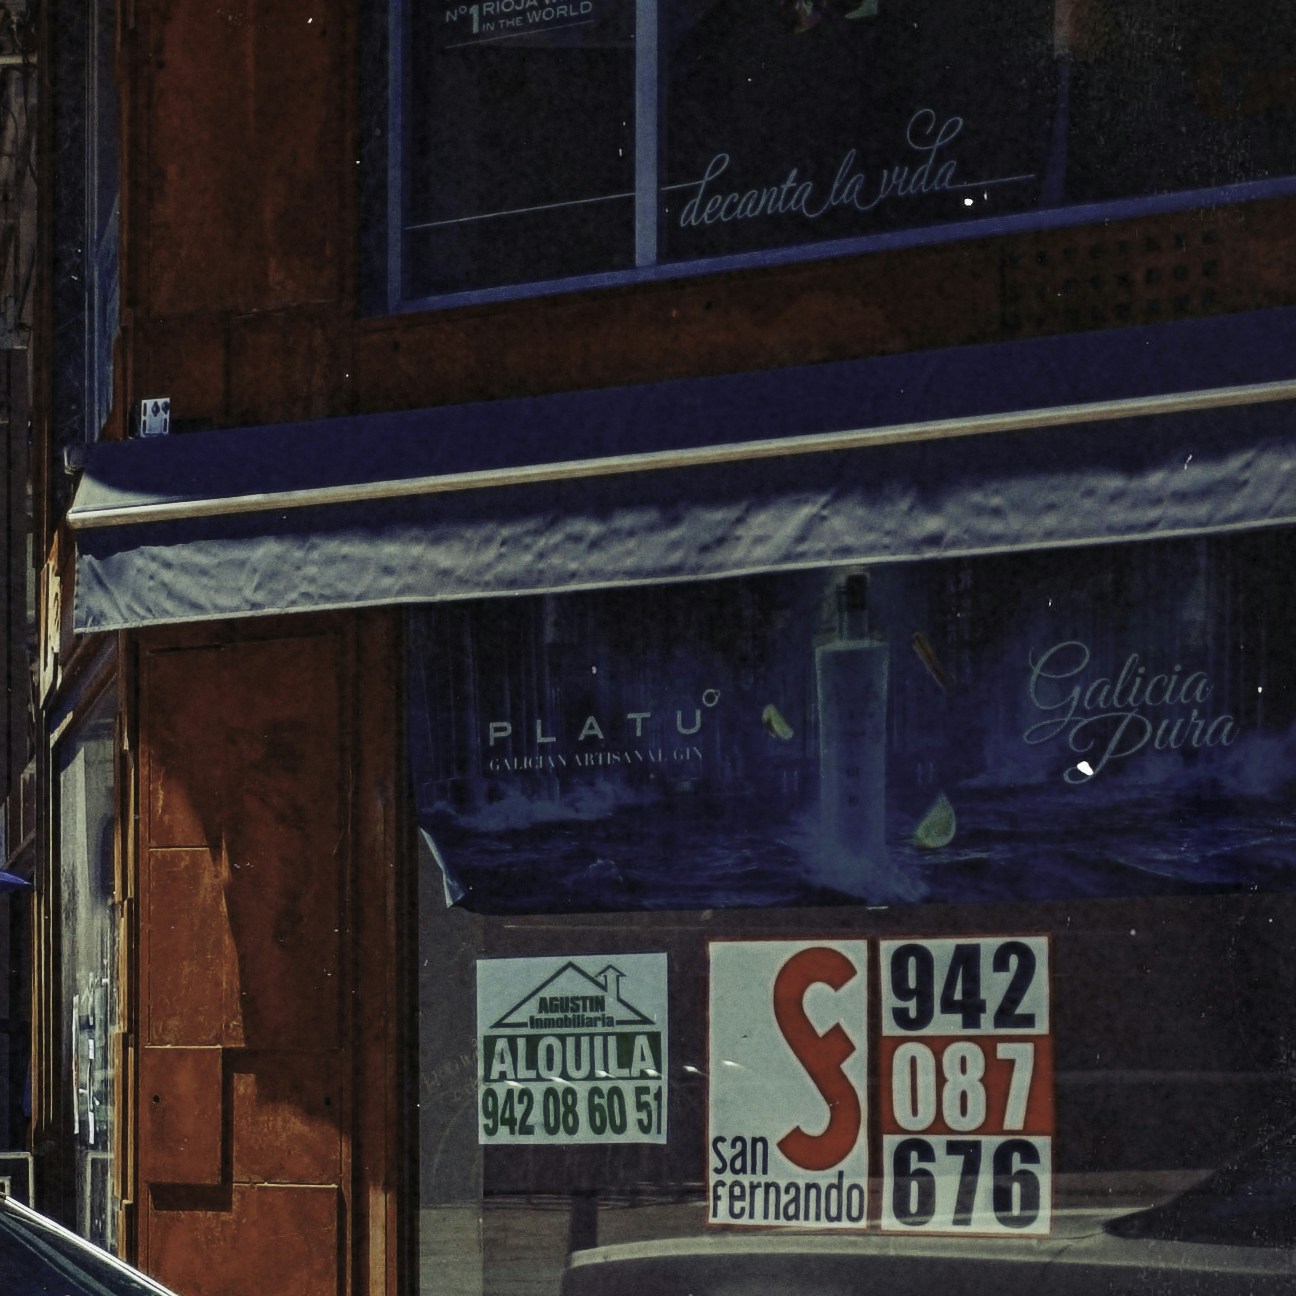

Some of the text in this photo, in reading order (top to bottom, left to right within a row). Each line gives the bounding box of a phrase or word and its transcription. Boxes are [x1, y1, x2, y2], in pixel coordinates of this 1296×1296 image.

[483, 0, 538, 16] RIOJA
[483, 1, 592, 32] IN THE WORLD
[680, 109, 964, 227] decanta la vida
[1022, 641, 1214, 744] Galicia
[490, 746, 702, 772] GALICIAN ARTISANAL GIN
[1063, 708, 1240, 784] Pura
[538, 995, 605, 1014] AGUSTIN
[890, 941, 1037, 1032] 942
[529, 1014, 615, 1029] Inmobiliaria
[490, 1035, 657, 1080] ALQUILA
[482, 1085, 662, 1136] 942 08 60 51
[892, 1041, 1036, 1133] 087
[712, 1136, 769, 1176] san
[711, 1171, 865, 1224] fernando
[892, 1138, 1042, 1230] 676
